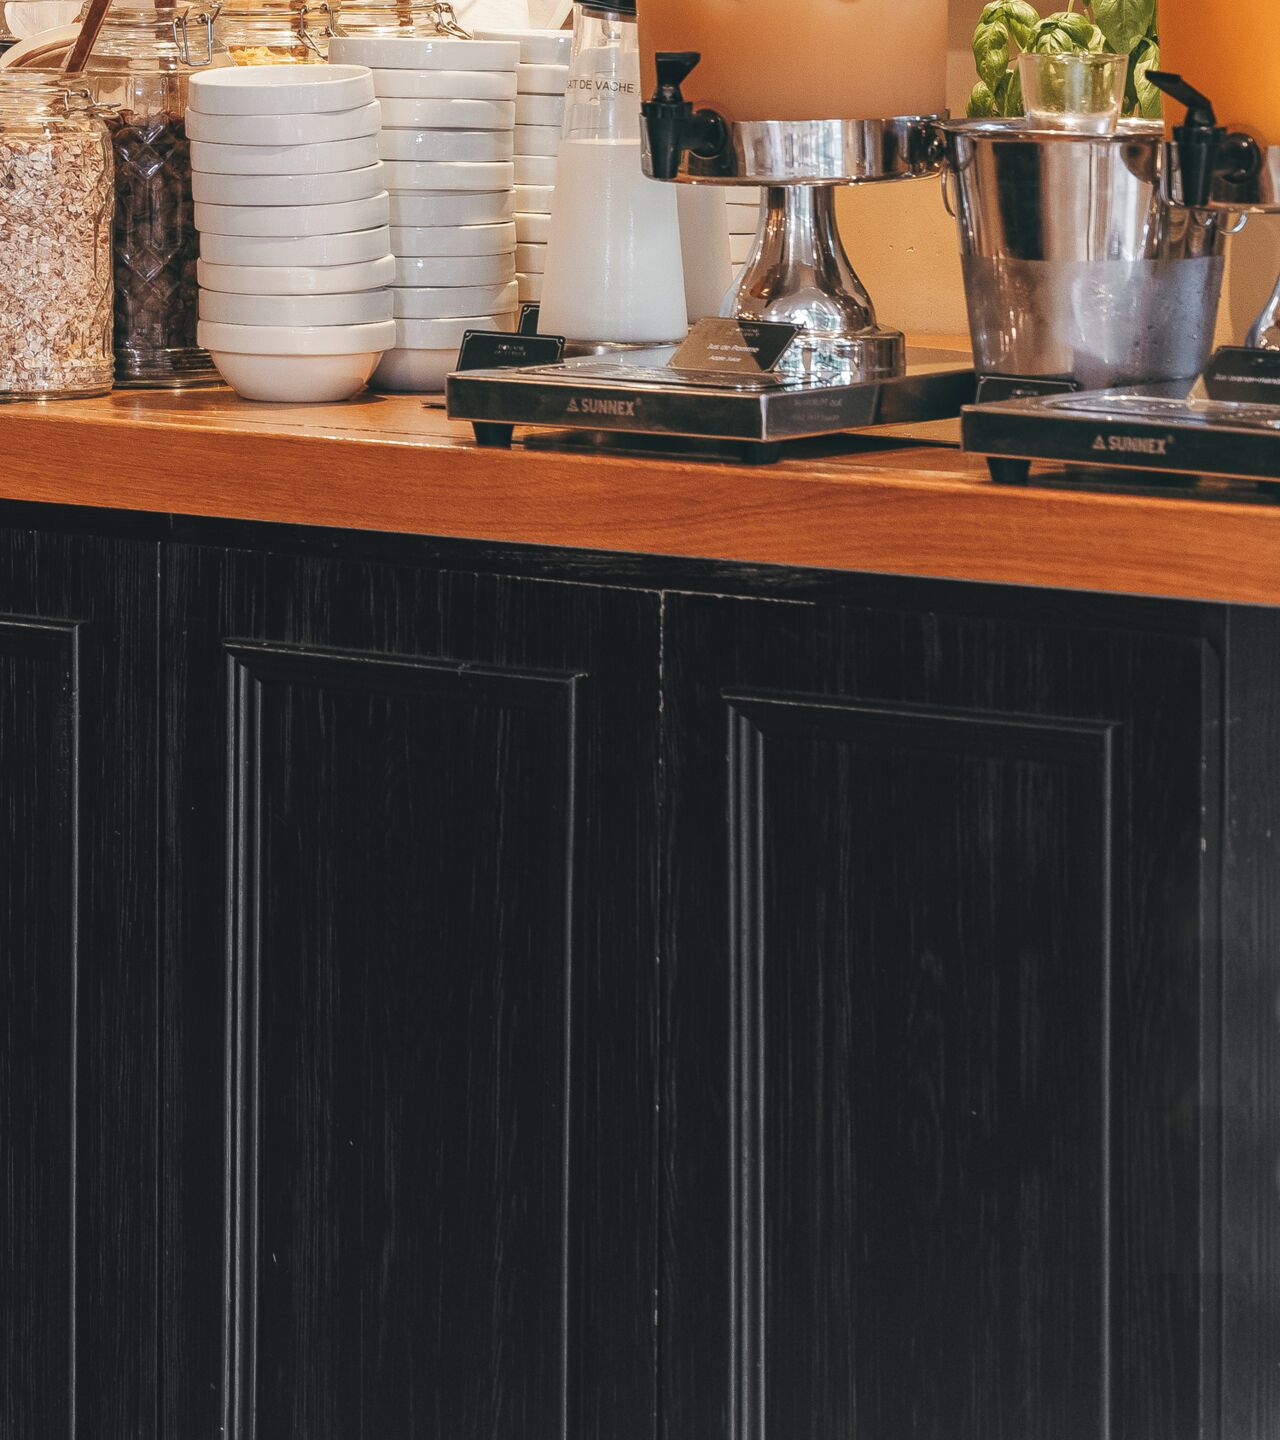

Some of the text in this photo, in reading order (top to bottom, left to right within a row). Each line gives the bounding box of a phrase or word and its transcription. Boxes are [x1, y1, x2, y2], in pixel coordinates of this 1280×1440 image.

[579, 79, 593, 90] DE
[594, 80, 635, 94] VACHE
[580, 398, 635, 416] SUNNEX
[1108, 435, 1167, 455] SUNNEX
